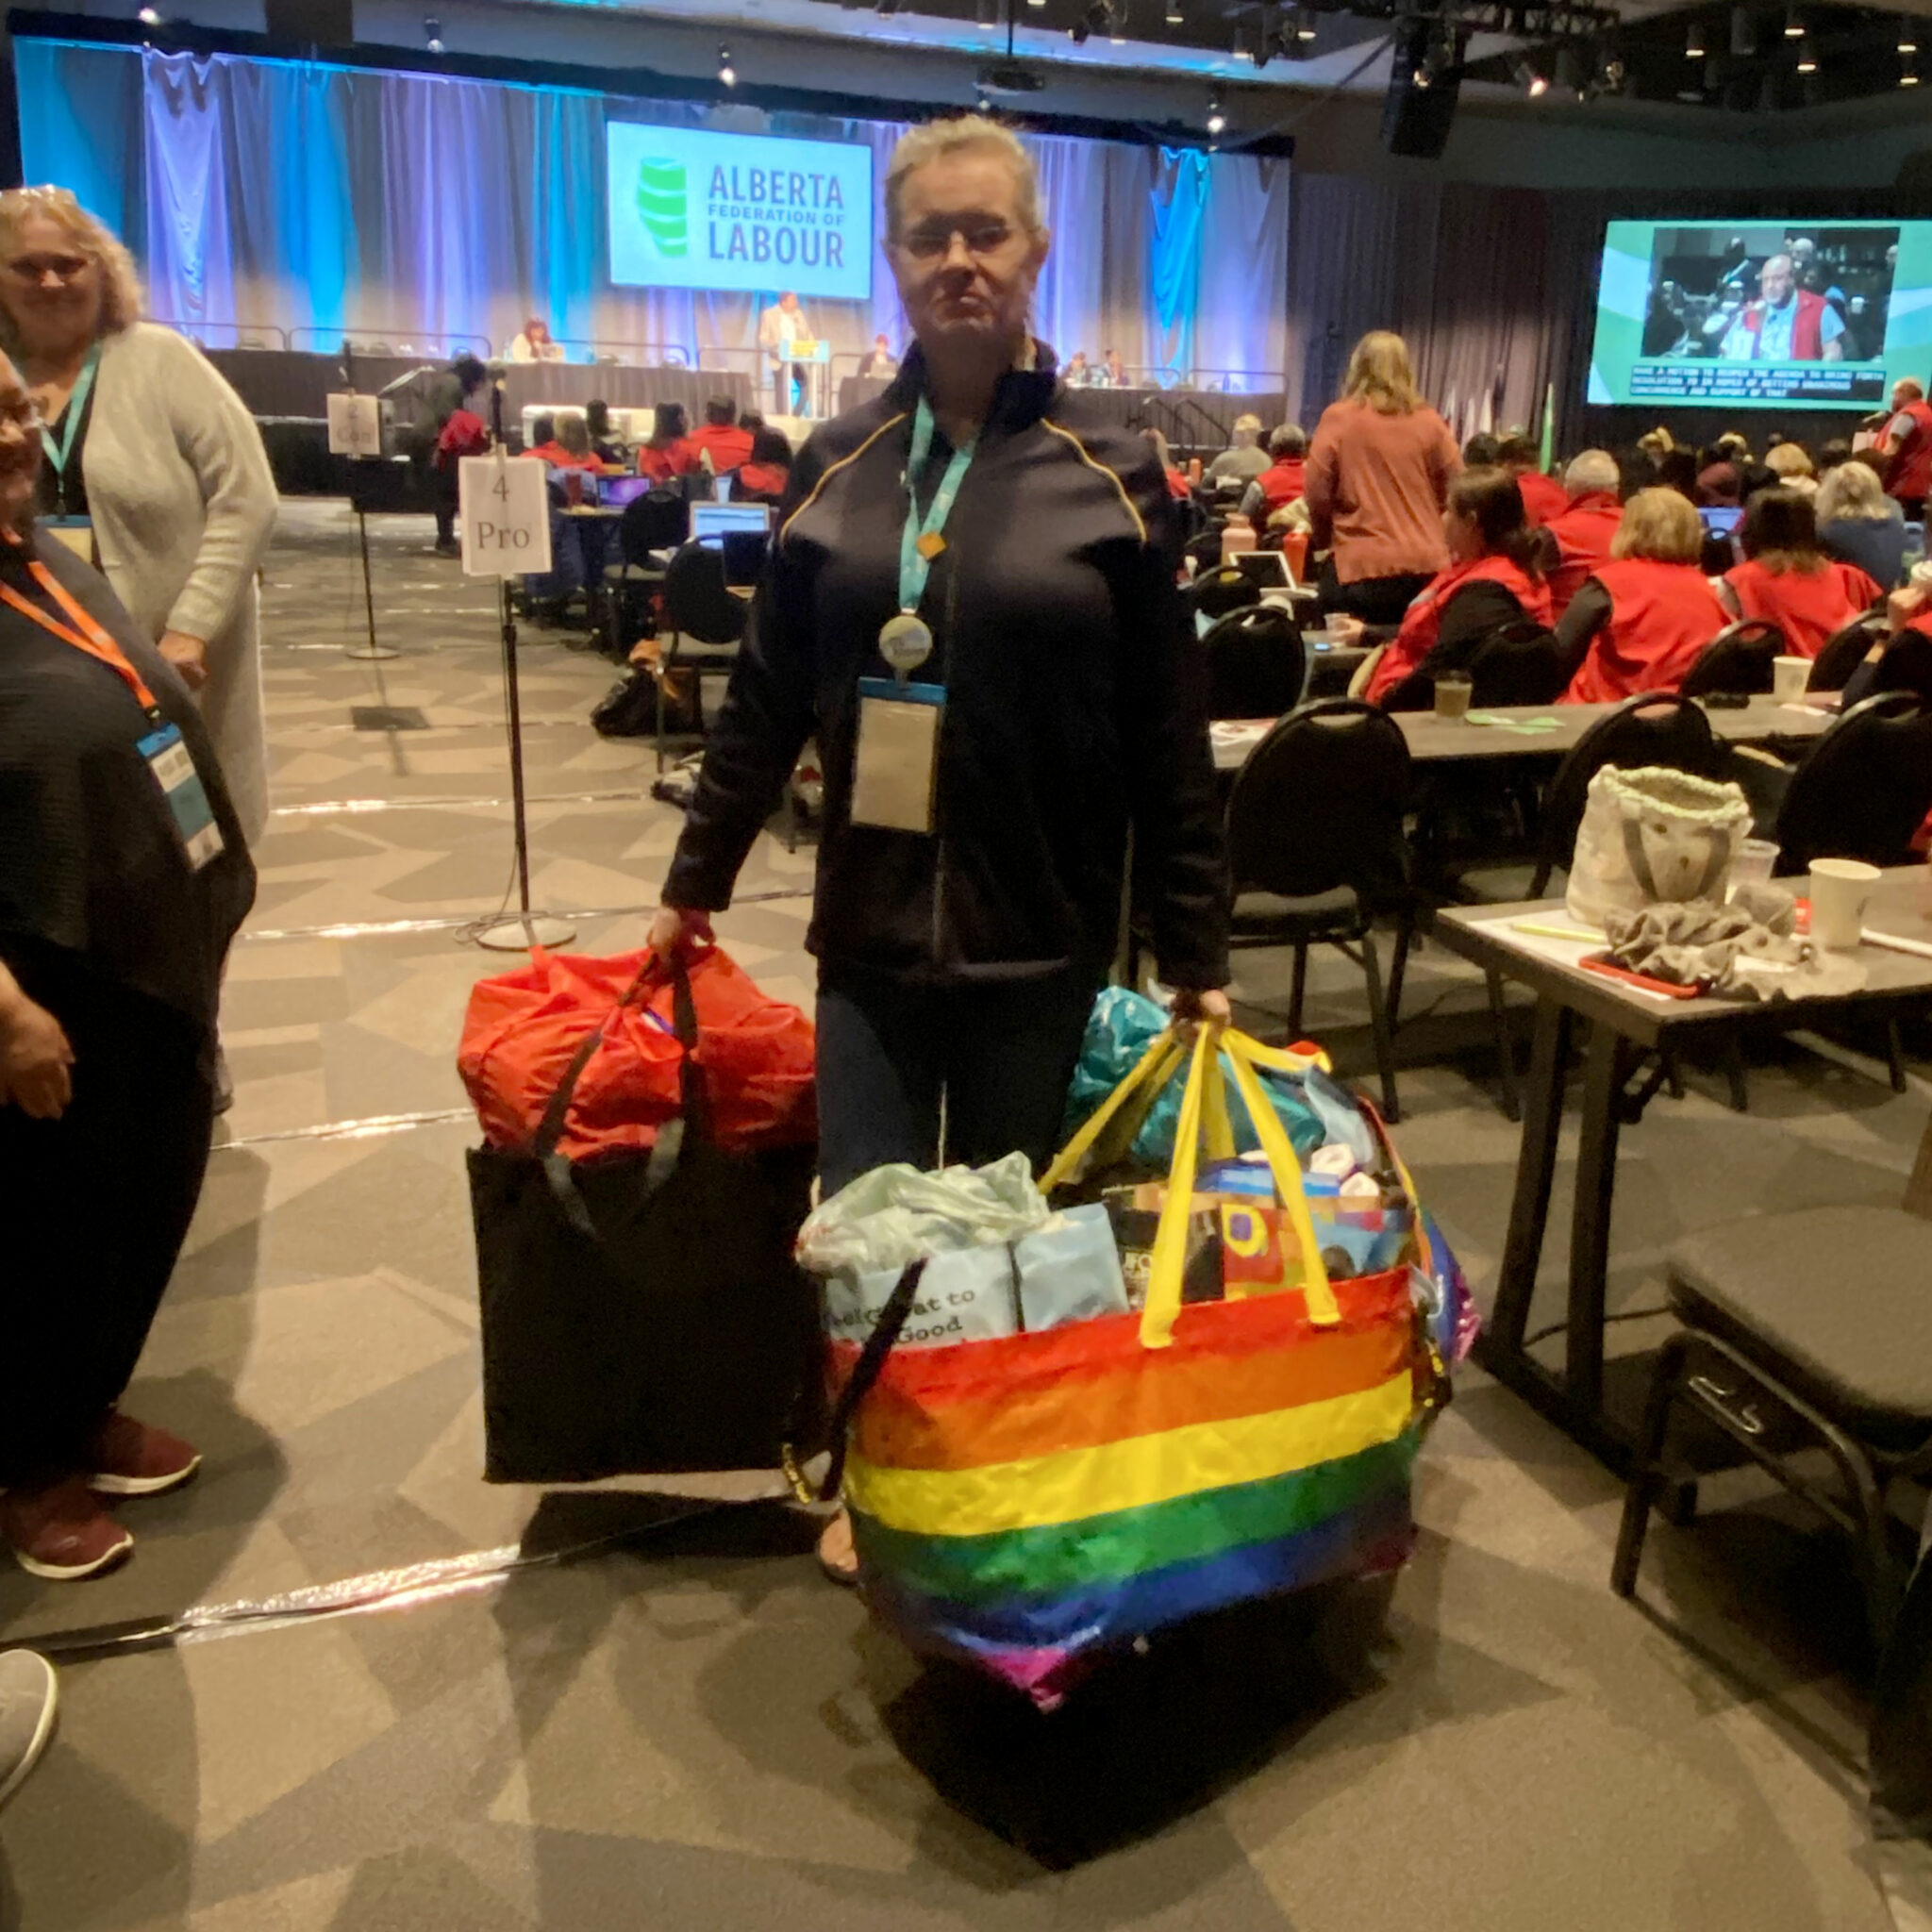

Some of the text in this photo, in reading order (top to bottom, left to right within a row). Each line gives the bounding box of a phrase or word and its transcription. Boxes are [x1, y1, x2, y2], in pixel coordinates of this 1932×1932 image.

[708, 164, 844, 209] ALBERTA
[708, 204, 845, 226] FEDERATION OF
[708, 221, 844, 269] LABOUR
[491, 475, 510, 503] 4
[476, 521, 531, 550] Pro
[946, 1289, 975, 1306] to
[896, 1314, 964, 1344] Good
